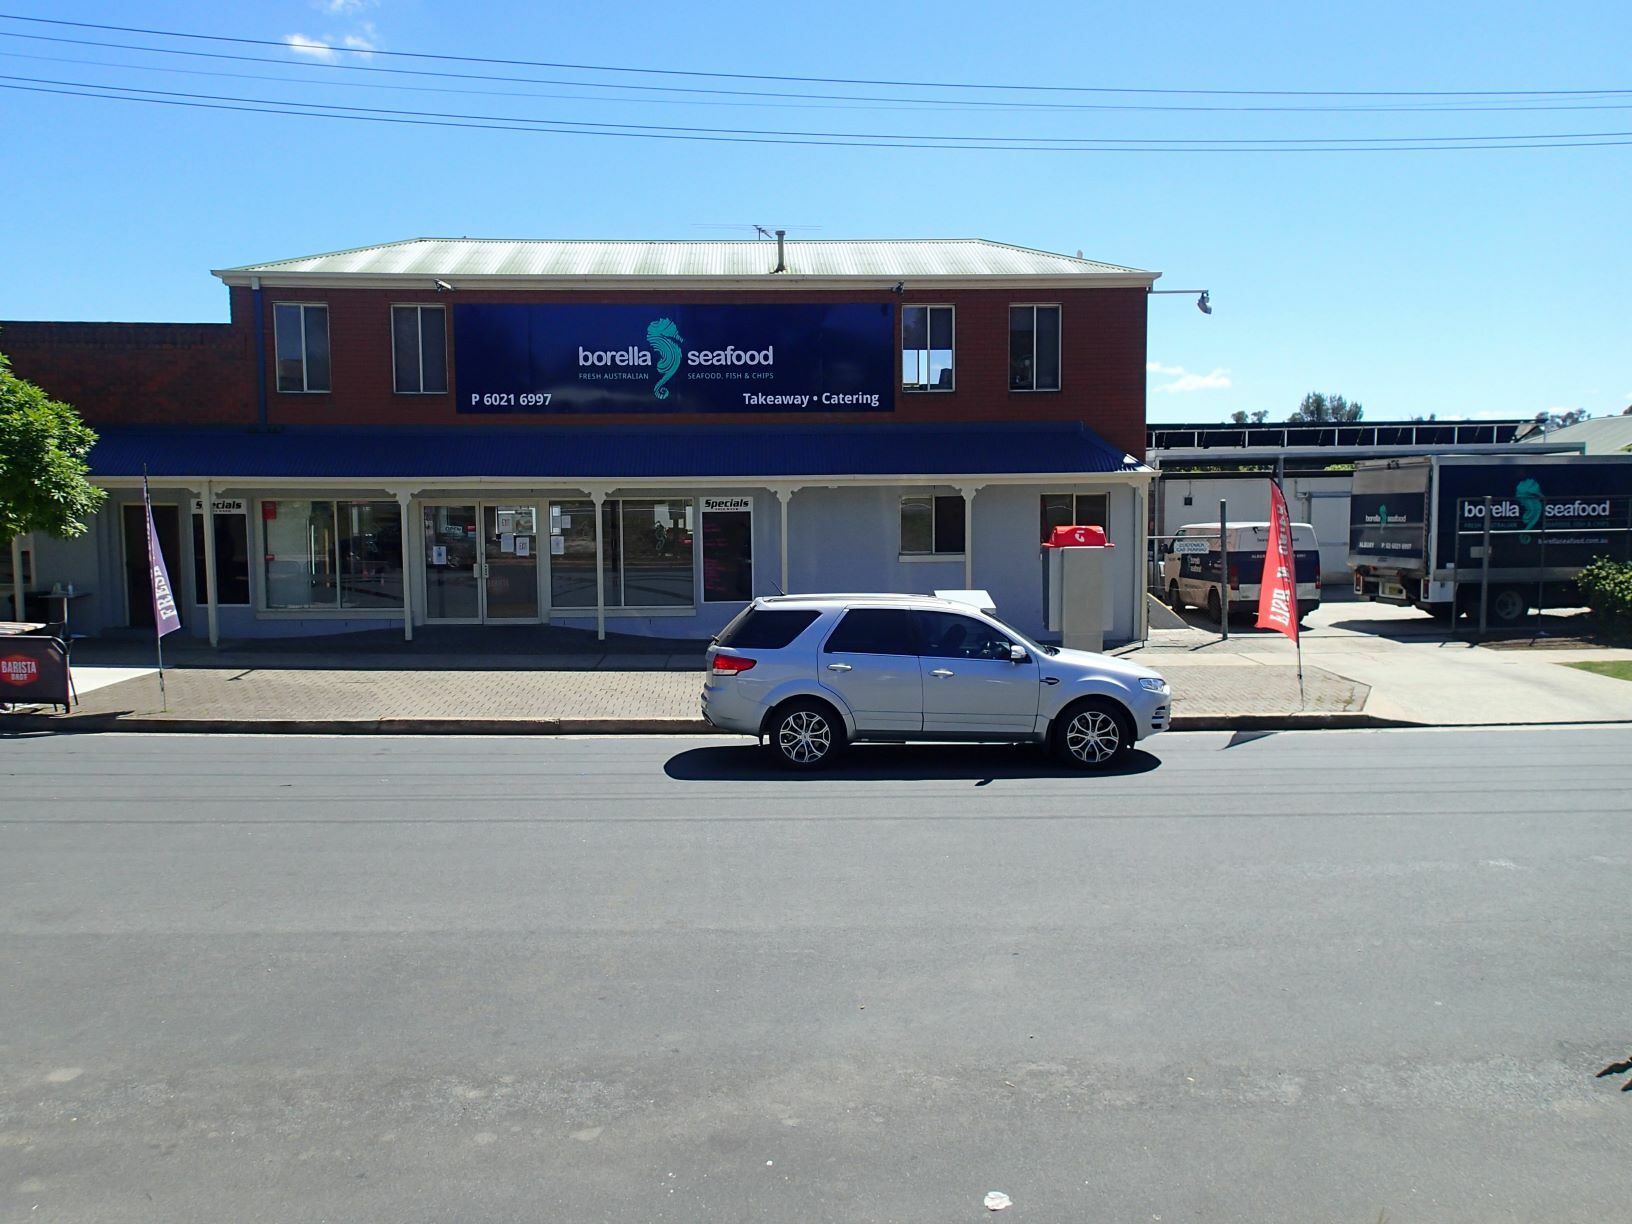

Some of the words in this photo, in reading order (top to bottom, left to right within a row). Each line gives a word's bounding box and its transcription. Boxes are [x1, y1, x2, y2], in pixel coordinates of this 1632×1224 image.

[578, 346, 652, 366] borella
[687, 345, 774, 366] seafood
[578, 372, 602, 380] FRESH
[603, 372, 649, 380] AUSTRALIAN
[687, 372, 724, 380] SEAFOOD,
[725, 372, 742, 380] FISH
[744, 372, 750, 380] &
[751, 372, 774, 380] CHIPS
[471, 393, 480, 406] P
[483, 393, 515, 406] 6021
[519, 393, 552, 406] 6997
[742, 392, 810, 408] Takeaway
[821, 391, 880, 407] Catering
[704, 498, 750, 509] Specials
[1544, 500, 1610, 517] seafood
[1, 660, 37, 674] BARISTA
